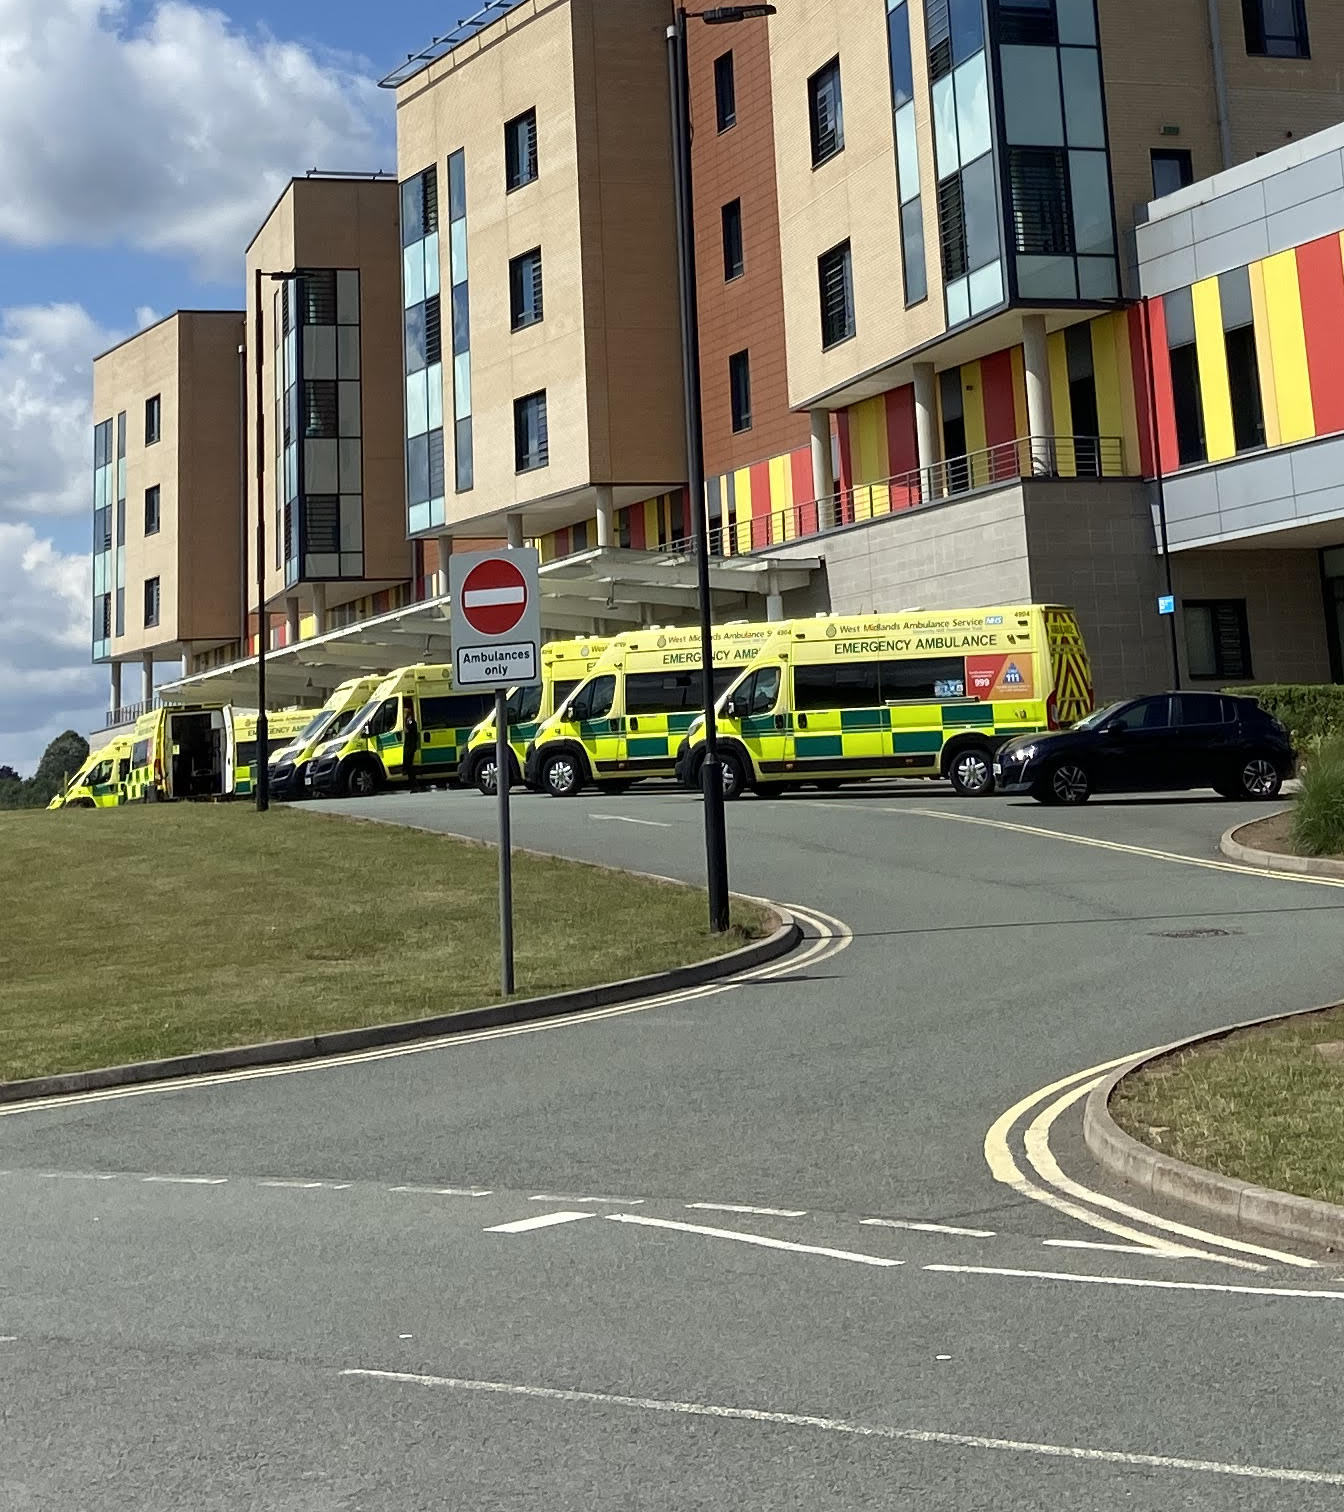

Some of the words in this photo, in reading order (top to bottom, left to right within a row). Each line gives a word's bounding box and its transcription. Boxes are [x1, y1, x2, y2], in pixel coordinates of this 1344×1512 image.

[840, 625, 860, 633] West
[864, 622, 900, 632] Midlands
[903, 619, 950, 630] Ambulance
[953, 617, 983, 627] Service
[986, 616, 1003, 625] NHS
[668, 635, 687, 644] West
[724, 631, 765, 639] Ambulance
[834, 638, 911, 654] EMERGENCY
[916, 634, 997, 650] AMBULANCE
[463, 650, 530, 664] Ambulances
[663, 650, 730, 664] EMERGCY
[484, 663, 508, 676] only
[1005, 673, 1020, 683] 111
